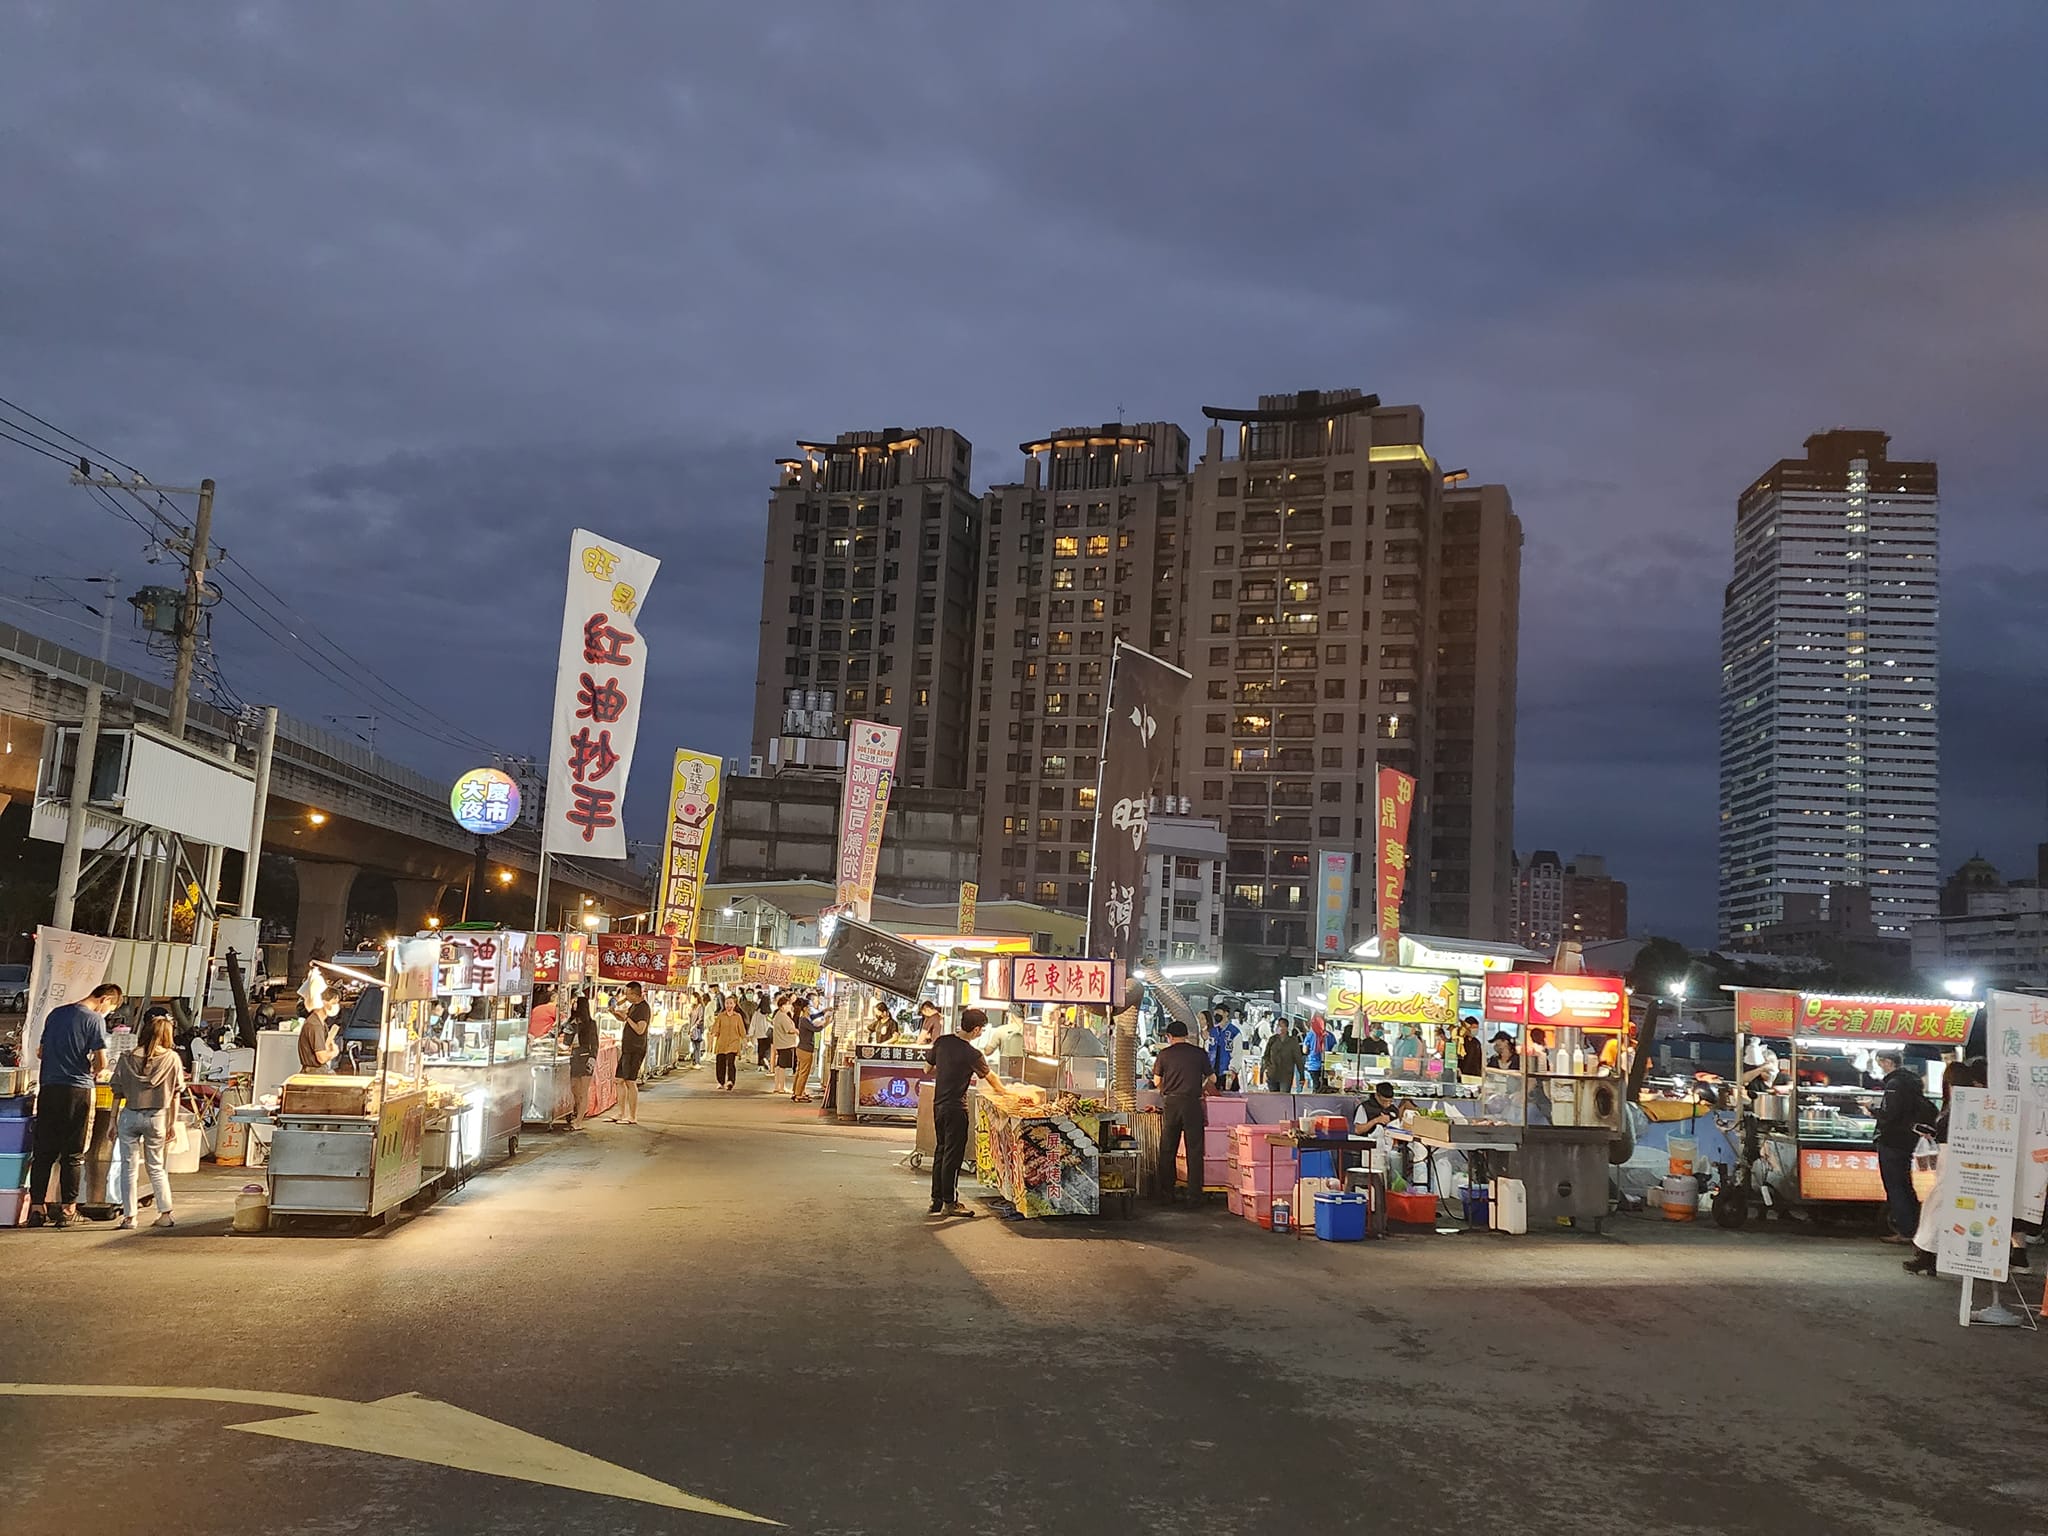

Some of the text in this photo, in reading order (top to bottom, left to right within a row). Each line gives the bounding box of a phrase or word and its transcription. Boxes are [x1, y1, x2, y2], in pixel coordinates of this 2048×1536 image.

[566, 612, 635, 842] 紅油抄手
[460, 780, 510, 801] 大慶
[460, 800, 509, 822] 夜市
[614, 938, 657, 954] 小馬哥
[603, 950, 666, 971] 麻辣魚蛋
[1020, 962, 1106, 999] 屏東烤肉
[1817, 1007, 1969, 1039] 老潼關肉夾饃
[881, 1047, 926, 1060] 感謝各大
[891, 1080, 906, 1096] 尚
[1046, 1133, 1061, 1200] 屏東烤肉
